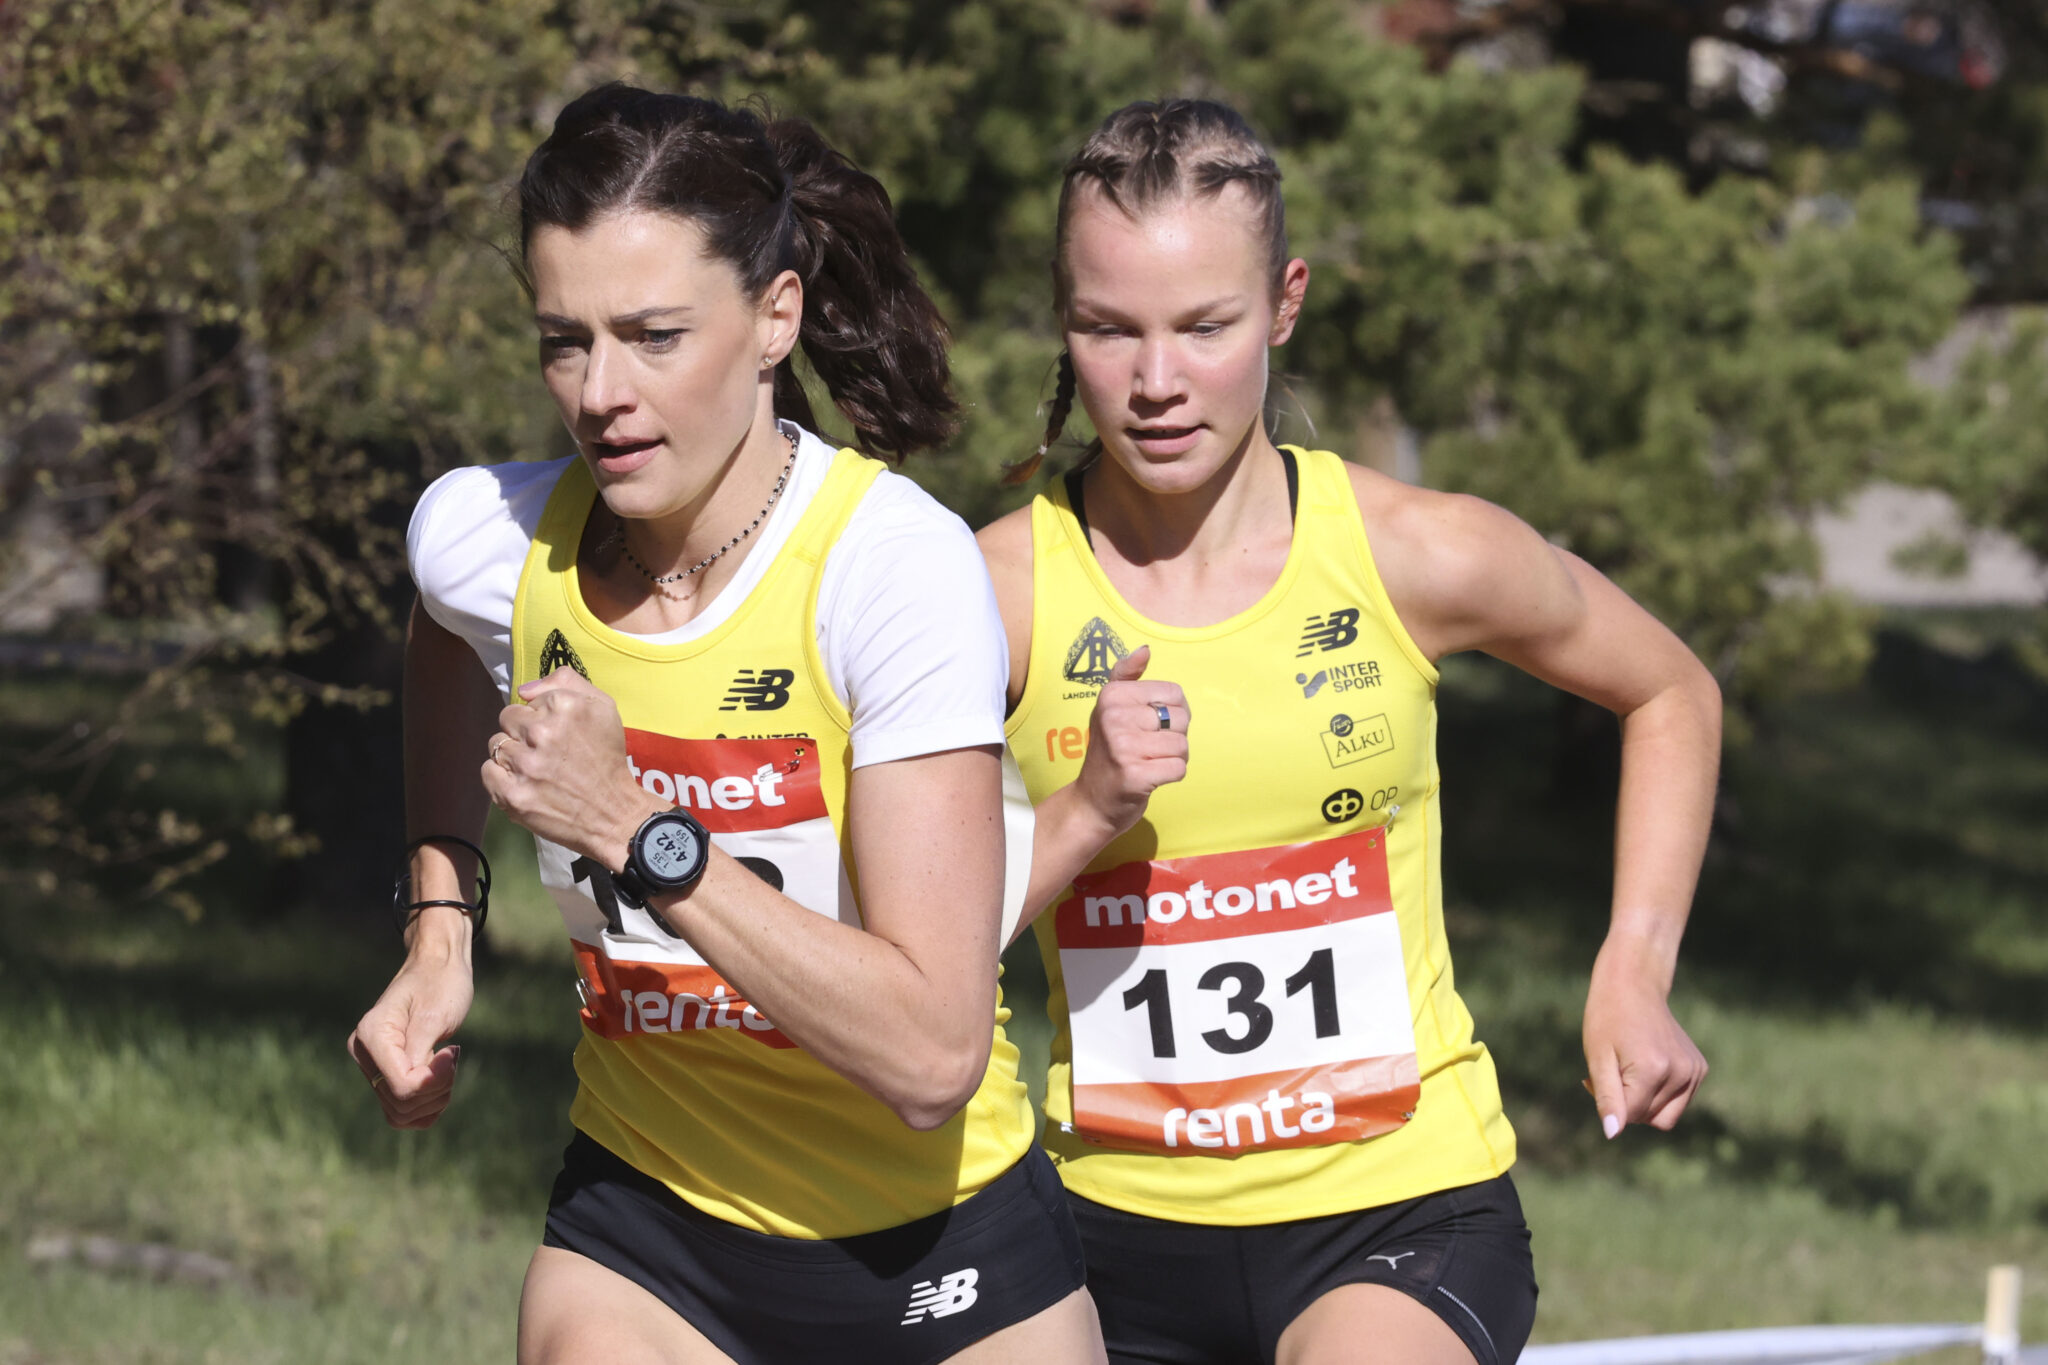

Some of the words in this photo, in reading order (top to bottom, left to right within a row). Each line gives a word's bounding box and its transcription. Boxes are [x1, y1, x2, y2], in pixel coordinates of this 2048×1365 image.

[1296, 607, 1360, 658] NB
[1328, 661, 1380, 682] INTER
[1333, 674, 1382, 693] SPORT
[719, 669, 794, 711] NB
[1062, 690, 1097, 700] LAHDEN
[1045, 726, 1090, 762] re
[1336, 728, 1385, 757] ALKU
[1370, 786, 1398, 811] OP
[656, 832, 688, 862] 4:42
[676, 829, 690, 844] 159
[1084, 856, 1359, 927] motonet
[1122, 947, 1341, 1059] 131
[1163, 1089, 1336, 1148] renta
[900, 1267, 979, 1325] NB
